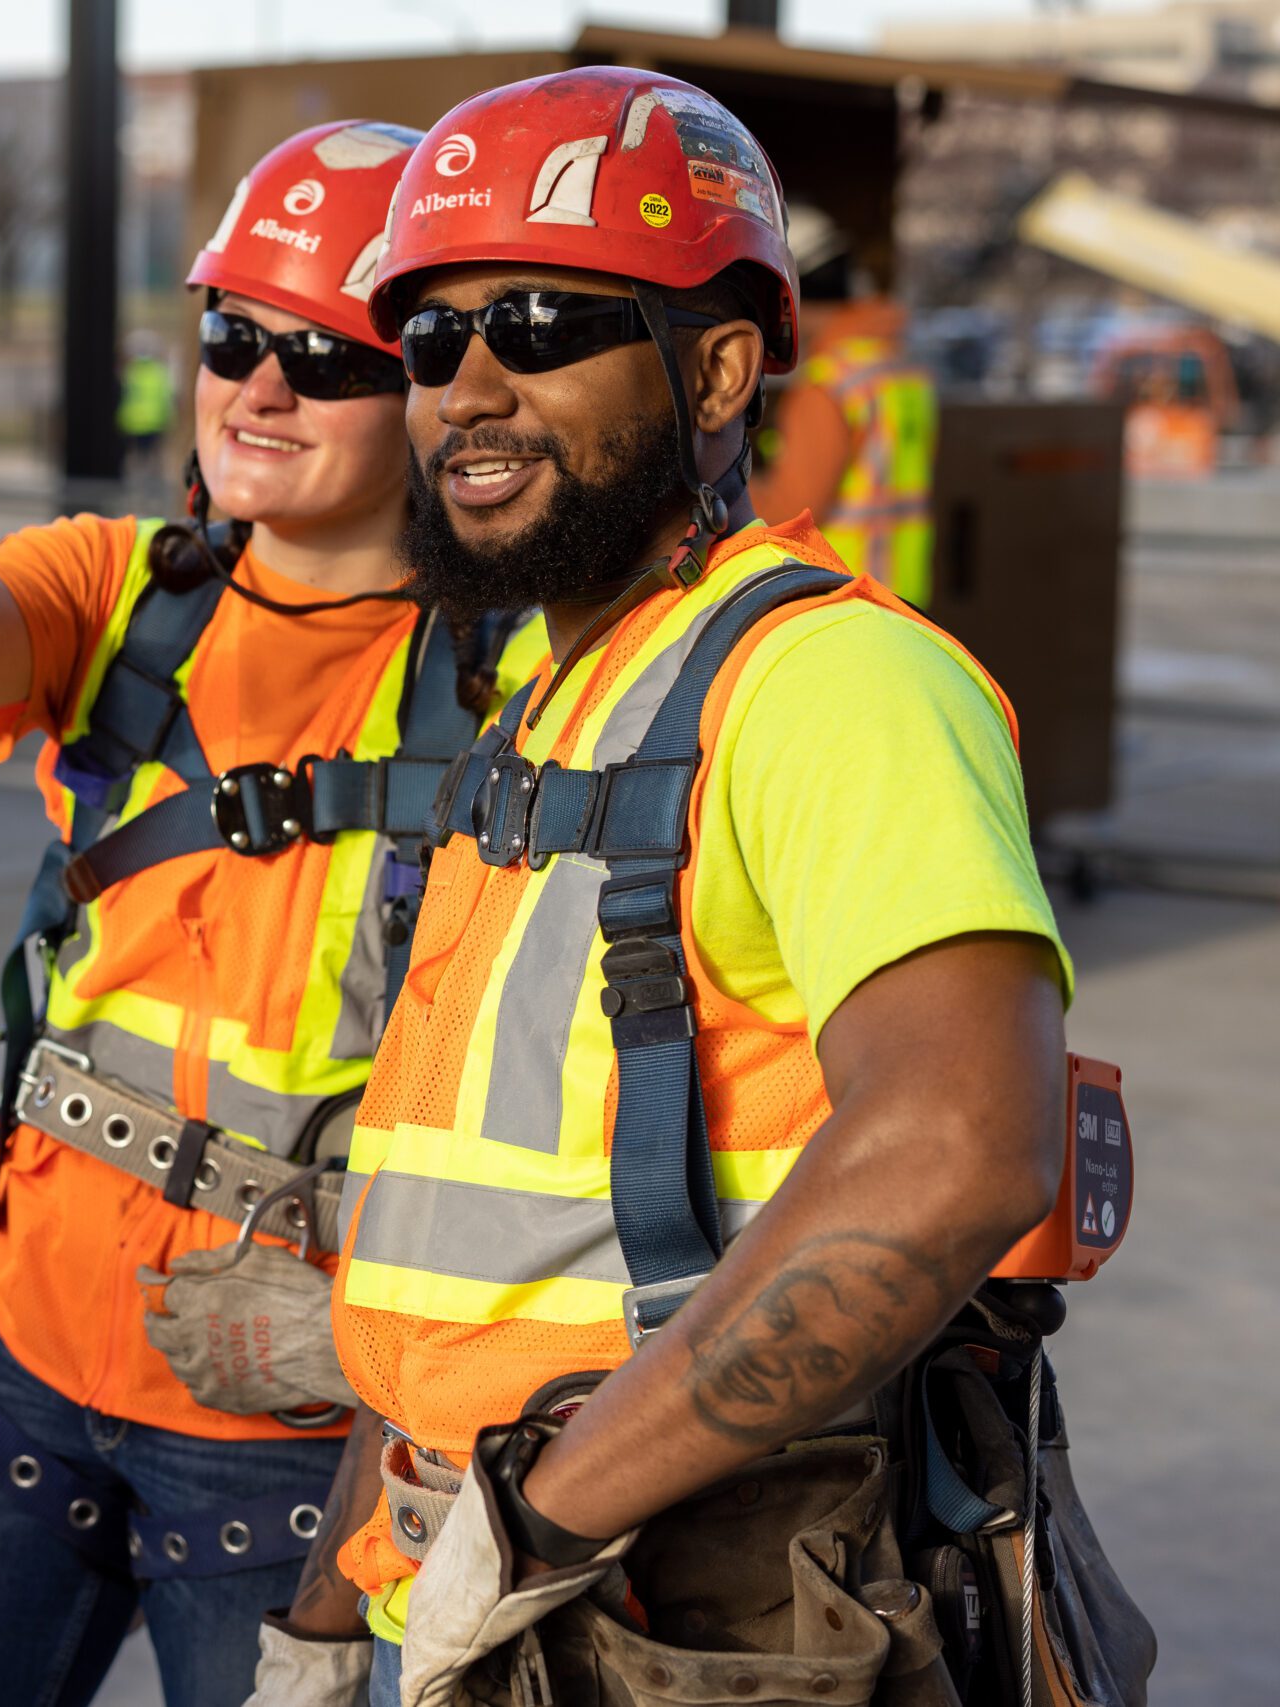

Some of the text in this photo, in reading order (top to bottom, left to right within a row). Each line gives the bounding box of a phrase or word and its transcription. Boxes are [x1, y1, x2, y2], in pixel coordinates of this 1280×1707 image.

[409, 188, 492, 219] Alberici
[643, 202, 669, 217] 2022
[250, 218, 322, 254] Alberici
[1078, 1112, 1098, 1141] 3M
[1085, 1158, 1118, 1179] Nano-Lok
[1102, 1181, 1118, 1197] edge
